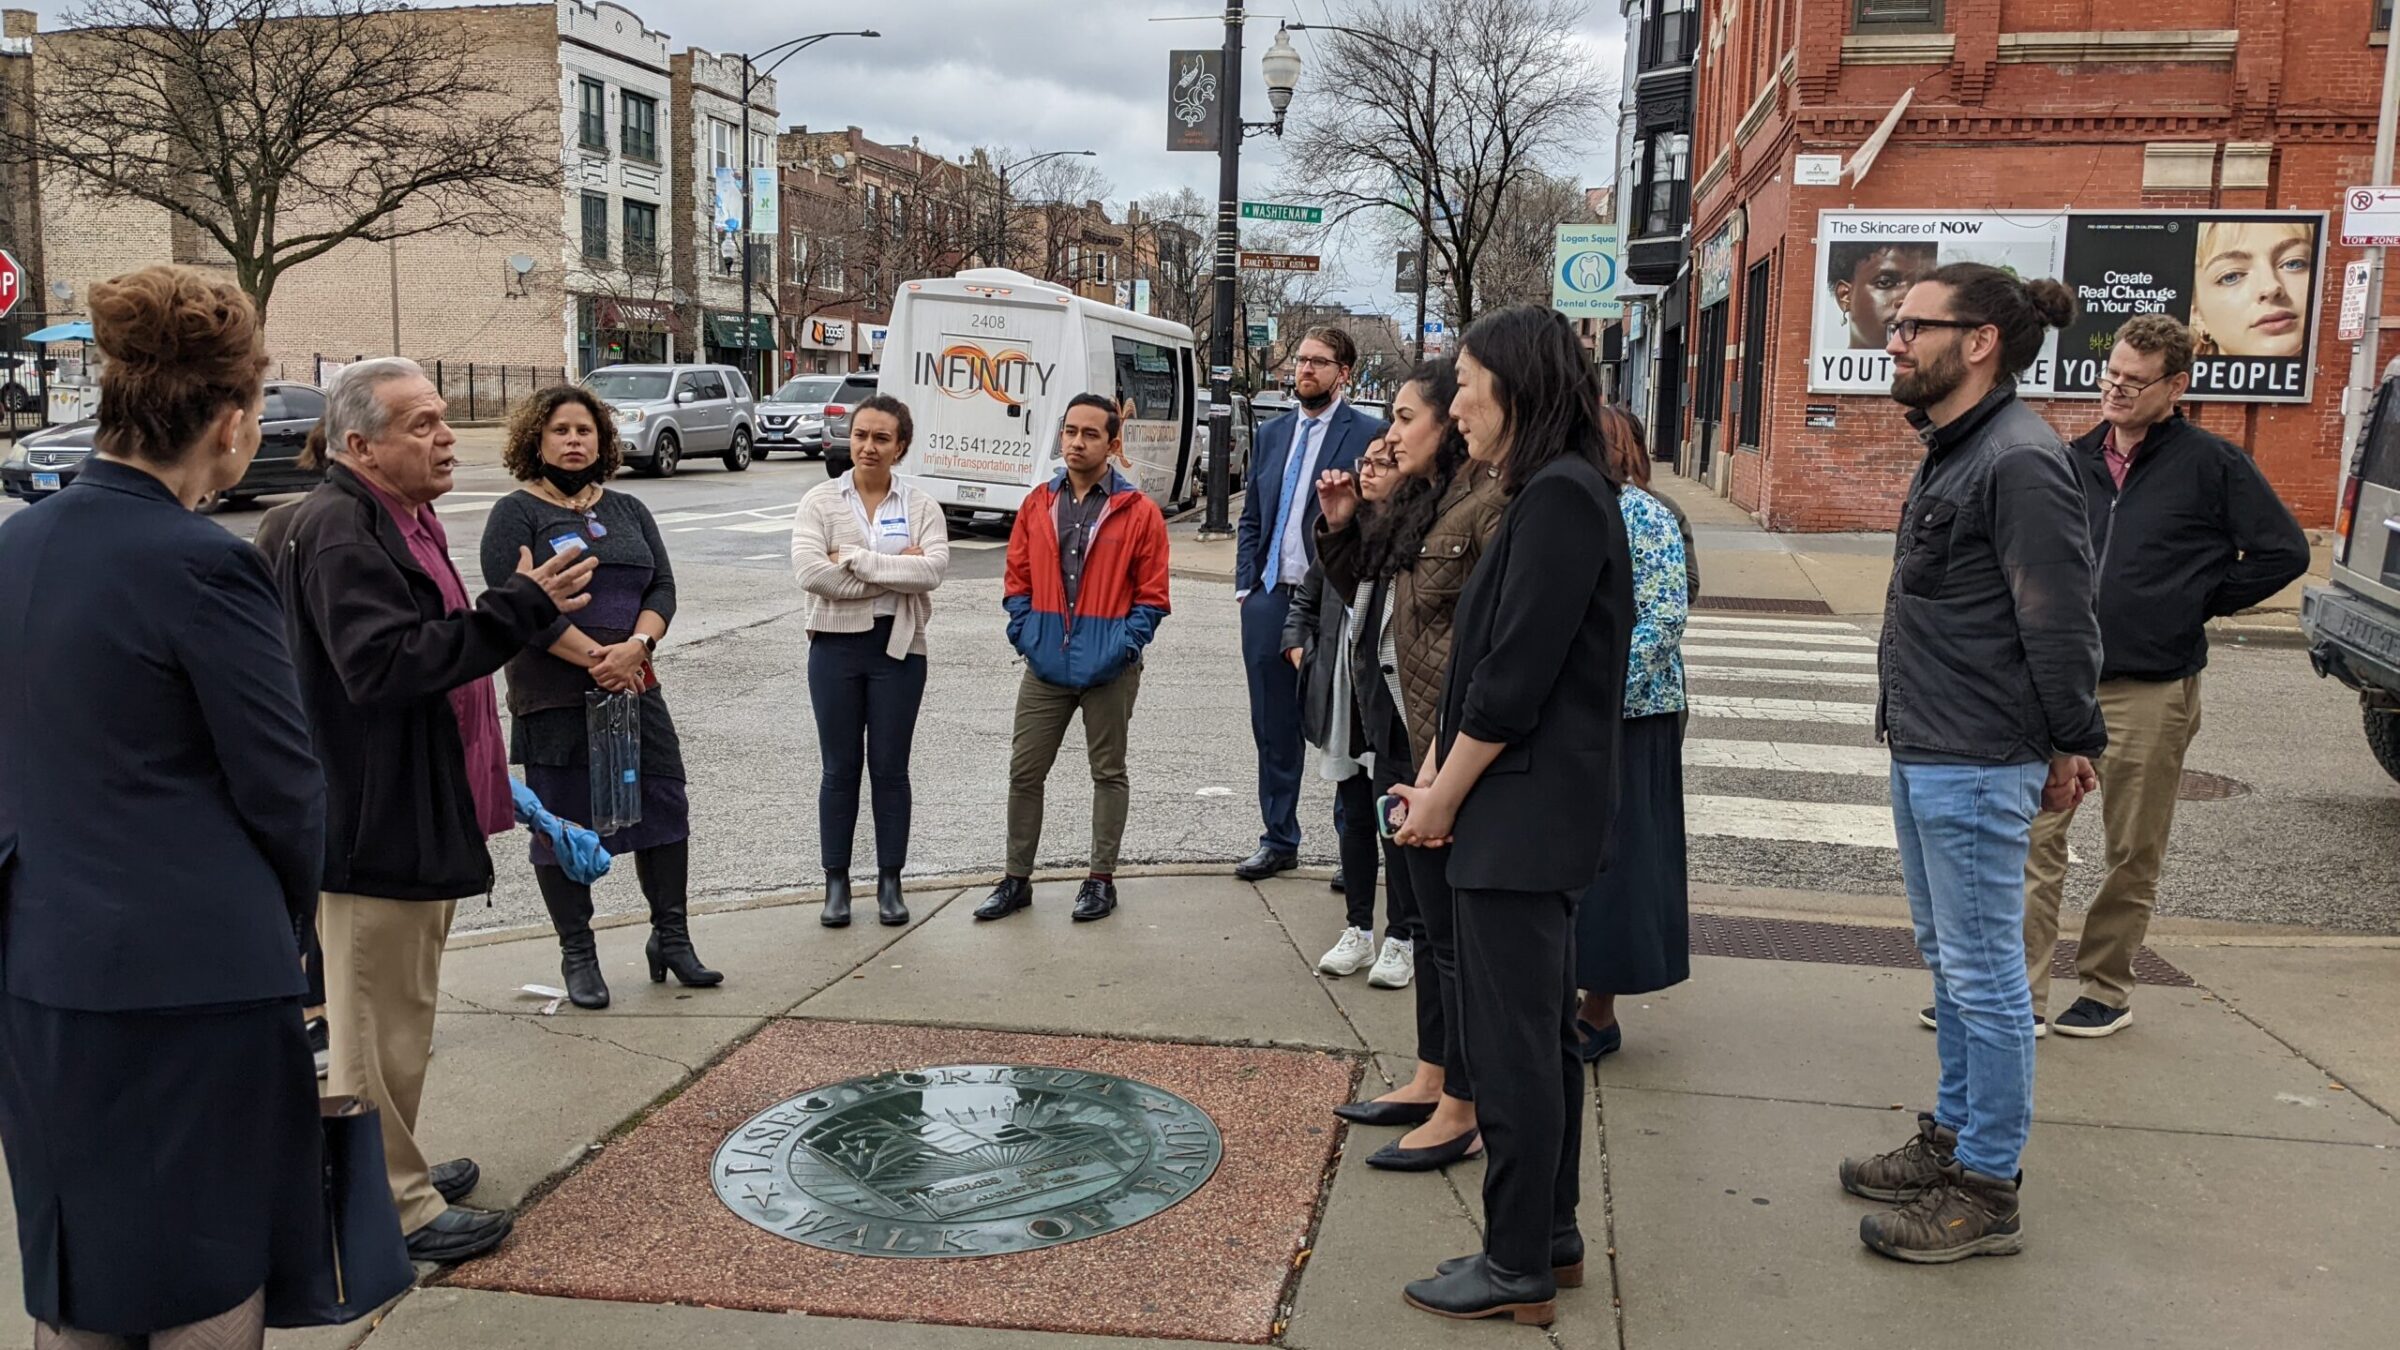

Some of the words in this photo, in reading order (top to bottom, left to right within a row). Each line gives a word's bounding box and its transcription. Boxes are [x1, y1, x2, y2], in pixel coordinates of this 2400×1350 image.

[1252, 205, 1309, 220] WASHTENAW
[1830, 221, 1857, 234] The
[1860, 221, 1920, 234] Skincare
[1922, 221, 1936, 234] of
[1940, 221, 1983, 234] NOW
[1561, 234, 1588, 244] Logan
[1591, 234, 1616, 244] Squar
[2346, 236, 2367, 245] TOW
[2371, 236, 2399, 245] ZONE
[1243, 258, 1264, 267] STANLEY
[2104, 270, 2153, 284] Create
[2078, 285, 2109, 299] Real
[2111, 285, 2177, 302] Change
[1556, 299, 1587, 308] Dental
[1590, 300, 1620, 310] Group
[2086, 299, 2099, 312] in
[2101, 300, 2131, 312] Your
[2134, 300, 2165, 313] Skin
[971, 314, 1006, 329] 2408
[824, 324, 845, 338] boost
[914, 351, 1056, 396] INFINITY
[1822, 356, 1892, 382] YOUT
[2191, 360, 2301, 390] PEOPLE
[929, 433, 1032, 457] 312.541.2222
[924, 453, 1032, 474] InfinityTransportation.net
[785, 1209, 981, 1252] WALK
[1026, 1206, 1107, 1240] OF
[1131, 1121, 1210, 1197] FAME
